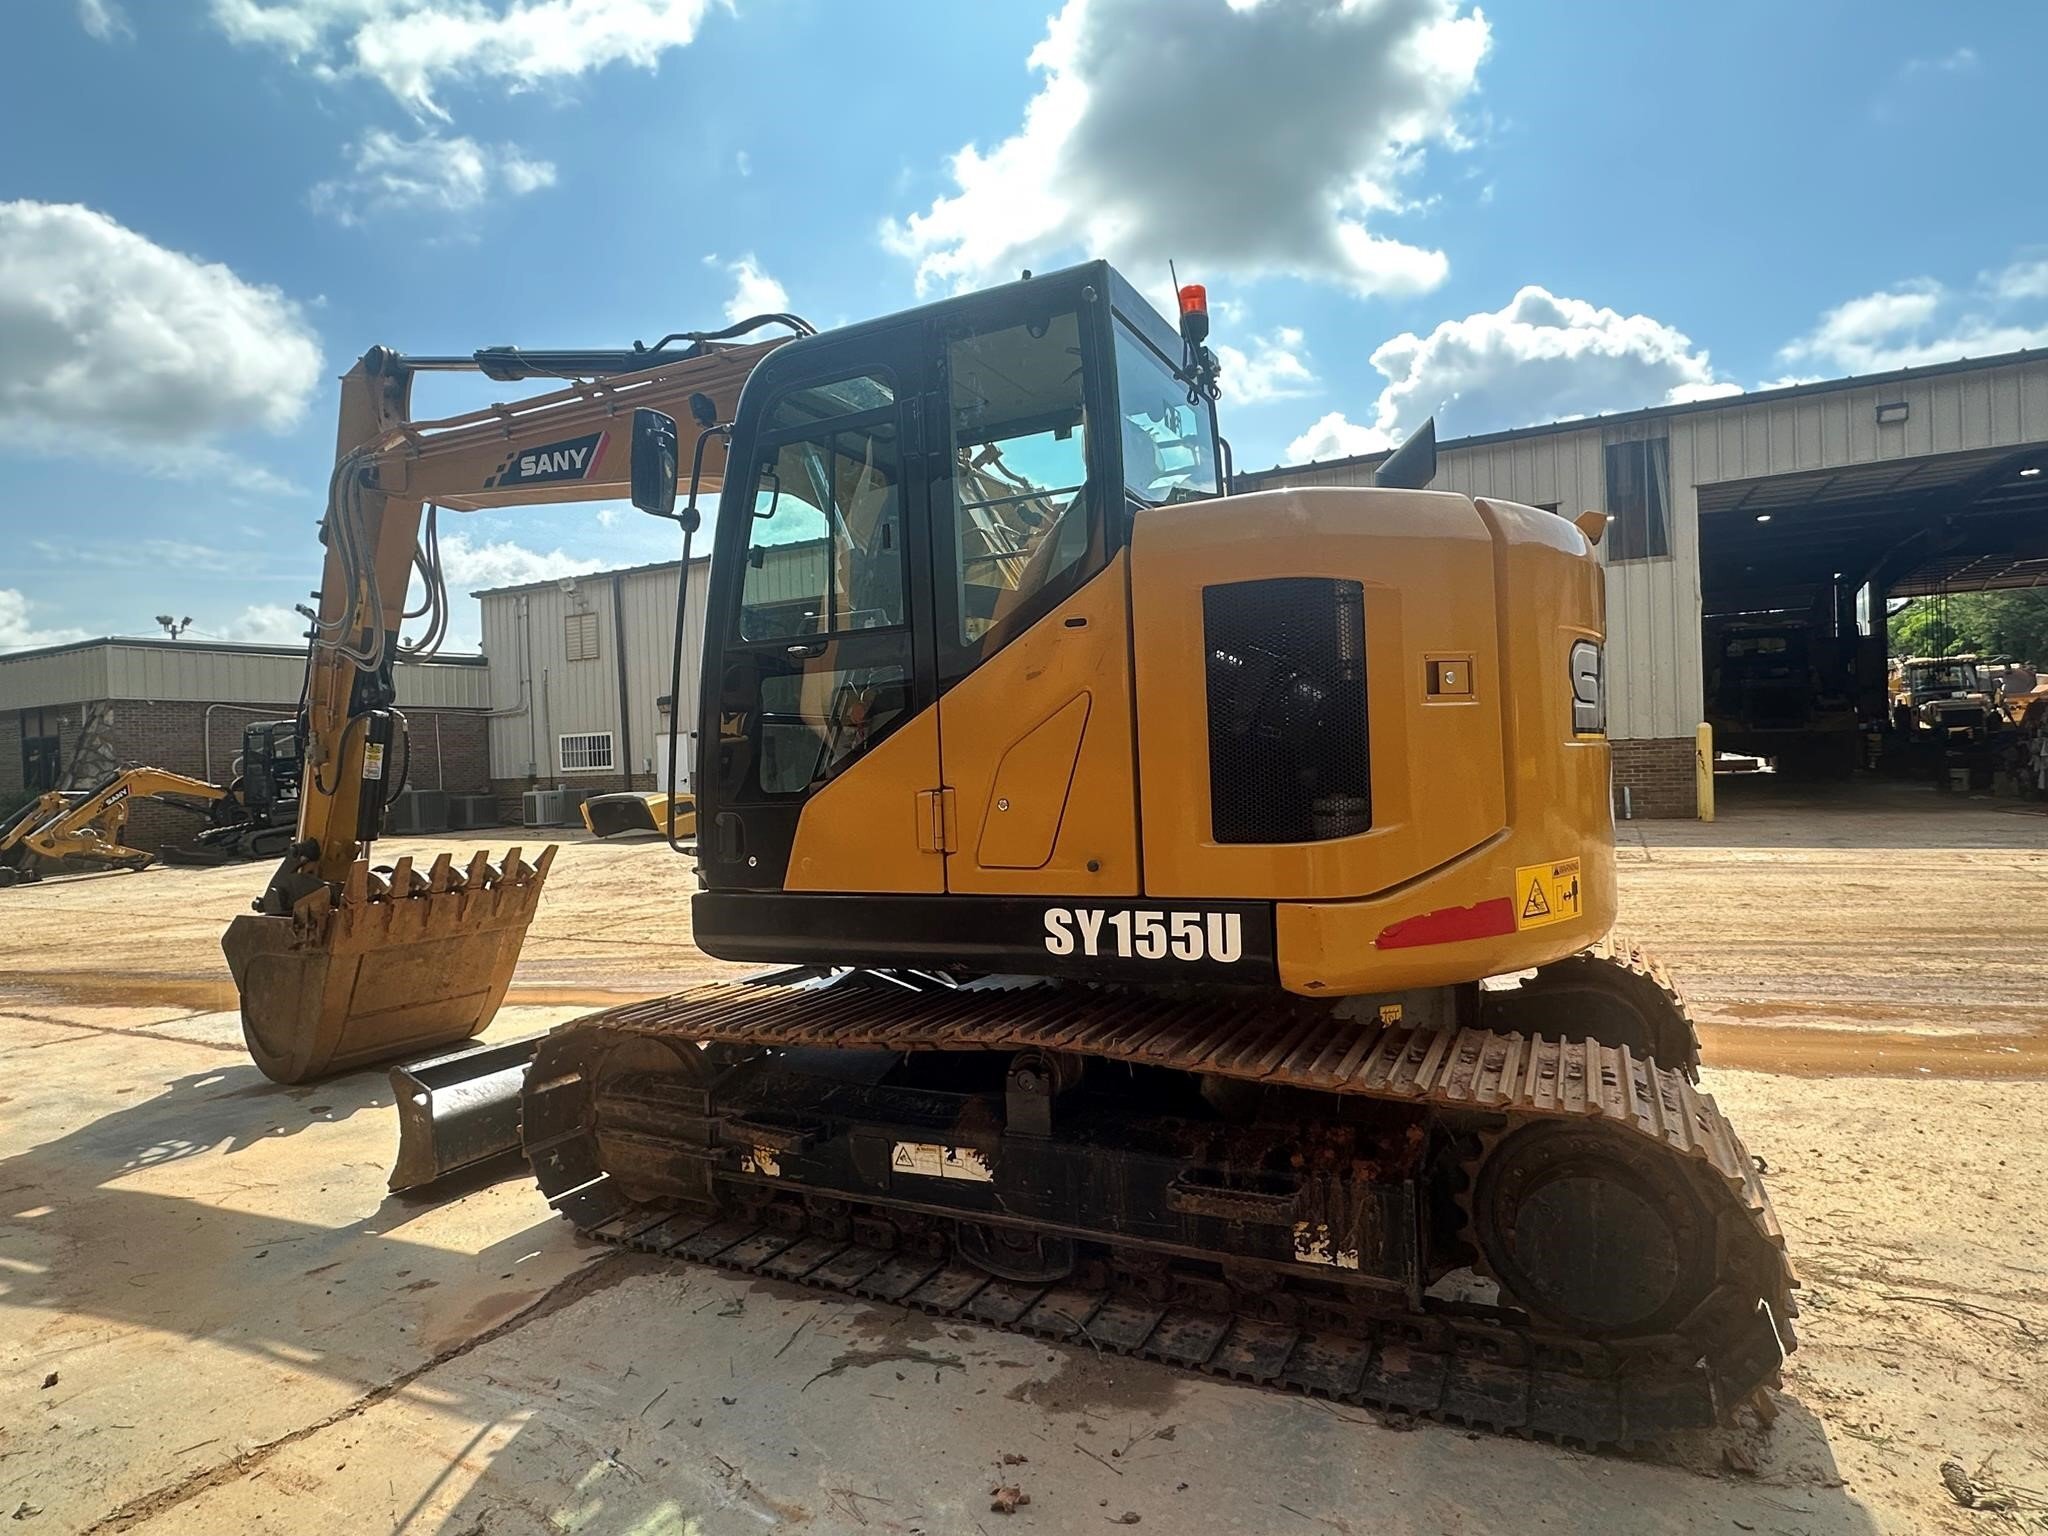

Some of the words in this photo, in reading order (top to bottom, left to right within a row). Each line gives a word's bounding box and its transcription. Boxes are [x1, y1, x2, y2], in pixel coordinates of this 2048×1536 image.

[521, 447, 588, 477] SANY
[106, 788, 128, 805] SANY
[1044, 908, 1242, 963] SY155U
